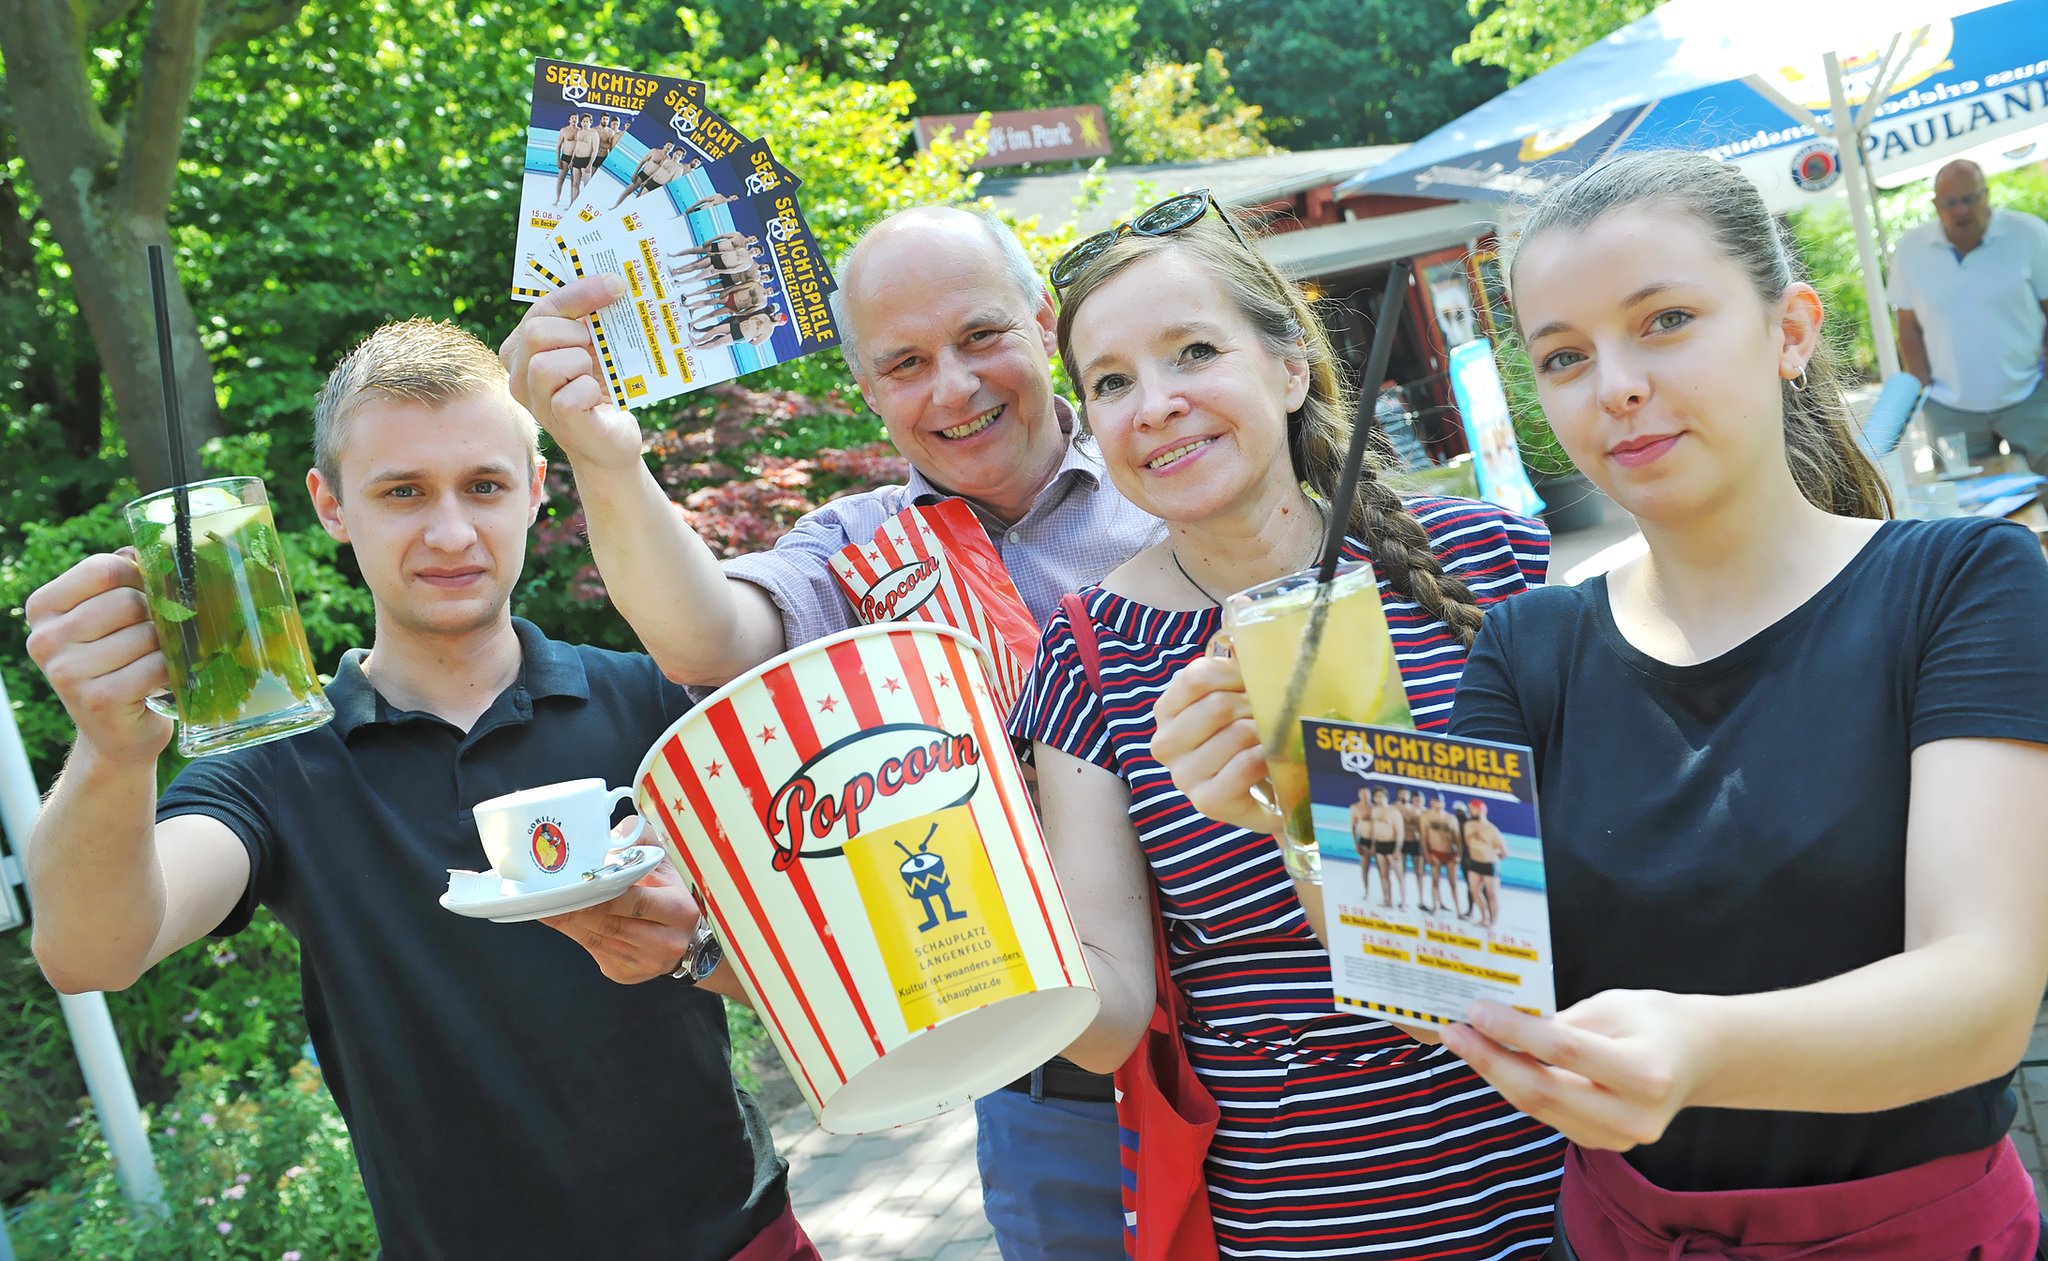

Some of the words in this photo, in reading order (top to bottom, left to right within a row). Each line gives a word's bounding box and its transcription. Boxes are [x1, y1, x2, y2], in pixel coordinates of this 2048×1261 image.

[587, 91, 601, 103] IM
[664, 89, 745, 154] SEELICHT
[689, 131, 705, 146] IM
[531, 209, 554, 219] 15.08.
[647, 236, 660, 260] 15.08.
[774, 242, 788, 258] IM
[625, 266, 639, 291] Yesterday
[632, 258, 646, 283] 23.08.
[775, 196, 835, 343] SEELICHTSPIELE
[637, 302, 647, 315] Once
[645, 297, 658, 323] 24.08.
[668, 300, 681, 324] 16.08.
[778, 260, 814, 340] FREIZEITPARK
[641, 315, 651, 328] Upon
[647, 332, 657, 344] Time
[652, 350, 666, 375] Hollywood
[682, 345, 695, 368] 17.08.
[860, 556, 940, 624] Popcorn
[1316, 727, 1521, 778] SEELICHTSPIELE
[1375, 759, 1394, 775] IM
[1397, 760, 1513, 793] FREIZEITPARK
[768, 733, 980, 872] Popcorn
[527, 816, 562, 834] GORILLA
[915, 926, 987, 957] SCHAUPLATZ
[920, 939, 992, 970] LANGENFELD
[899, 979, 928, 998] Kultur
[930, 975, 942, 986] ist
[944, 959, 990, 980] woanders
[992, 951, 1021, 966] anders
[937, 977, 1002, 1005] schauplatz.de
